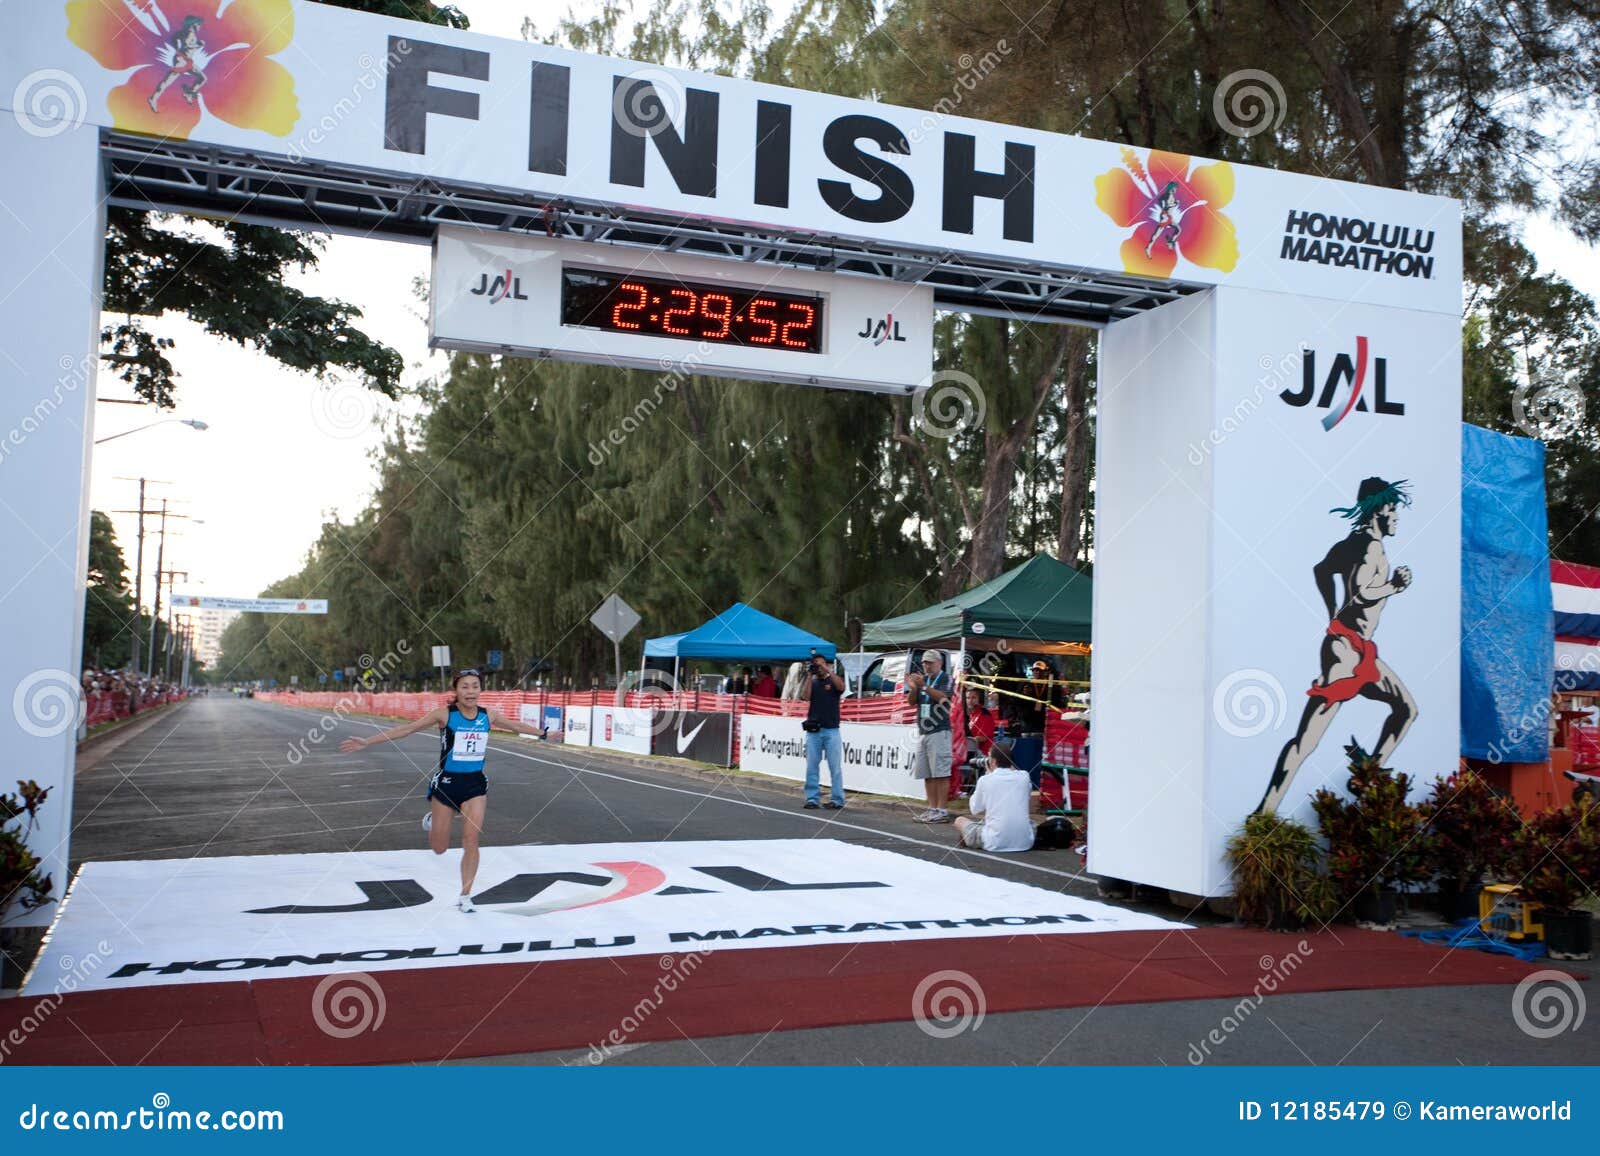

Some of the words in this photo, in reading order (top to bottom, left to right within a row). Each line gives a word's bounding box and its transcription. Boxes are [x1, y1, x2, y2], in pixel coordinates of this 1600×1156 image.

[384, 35, 1035, 243] FINISH
[1286, 209, 1435, 254] HONOLULU
[1280, 236, 1435, 280] MARATHON
[471, 269, 528, 304] JAL
[858, 313, 907, 346] JAL
[1279, 336, 1405, 432] JAL
[463, 732, 482, 740] JAL
[466, 741, 476, 752] F1
[842, 741, 862, 764] You
[865, 744, 883, 768] did
[242, 861, 893, 917] JAL
[106, 935, 636, 979] HONOLULU
[668, 913, 1094, 943] MARATHON
